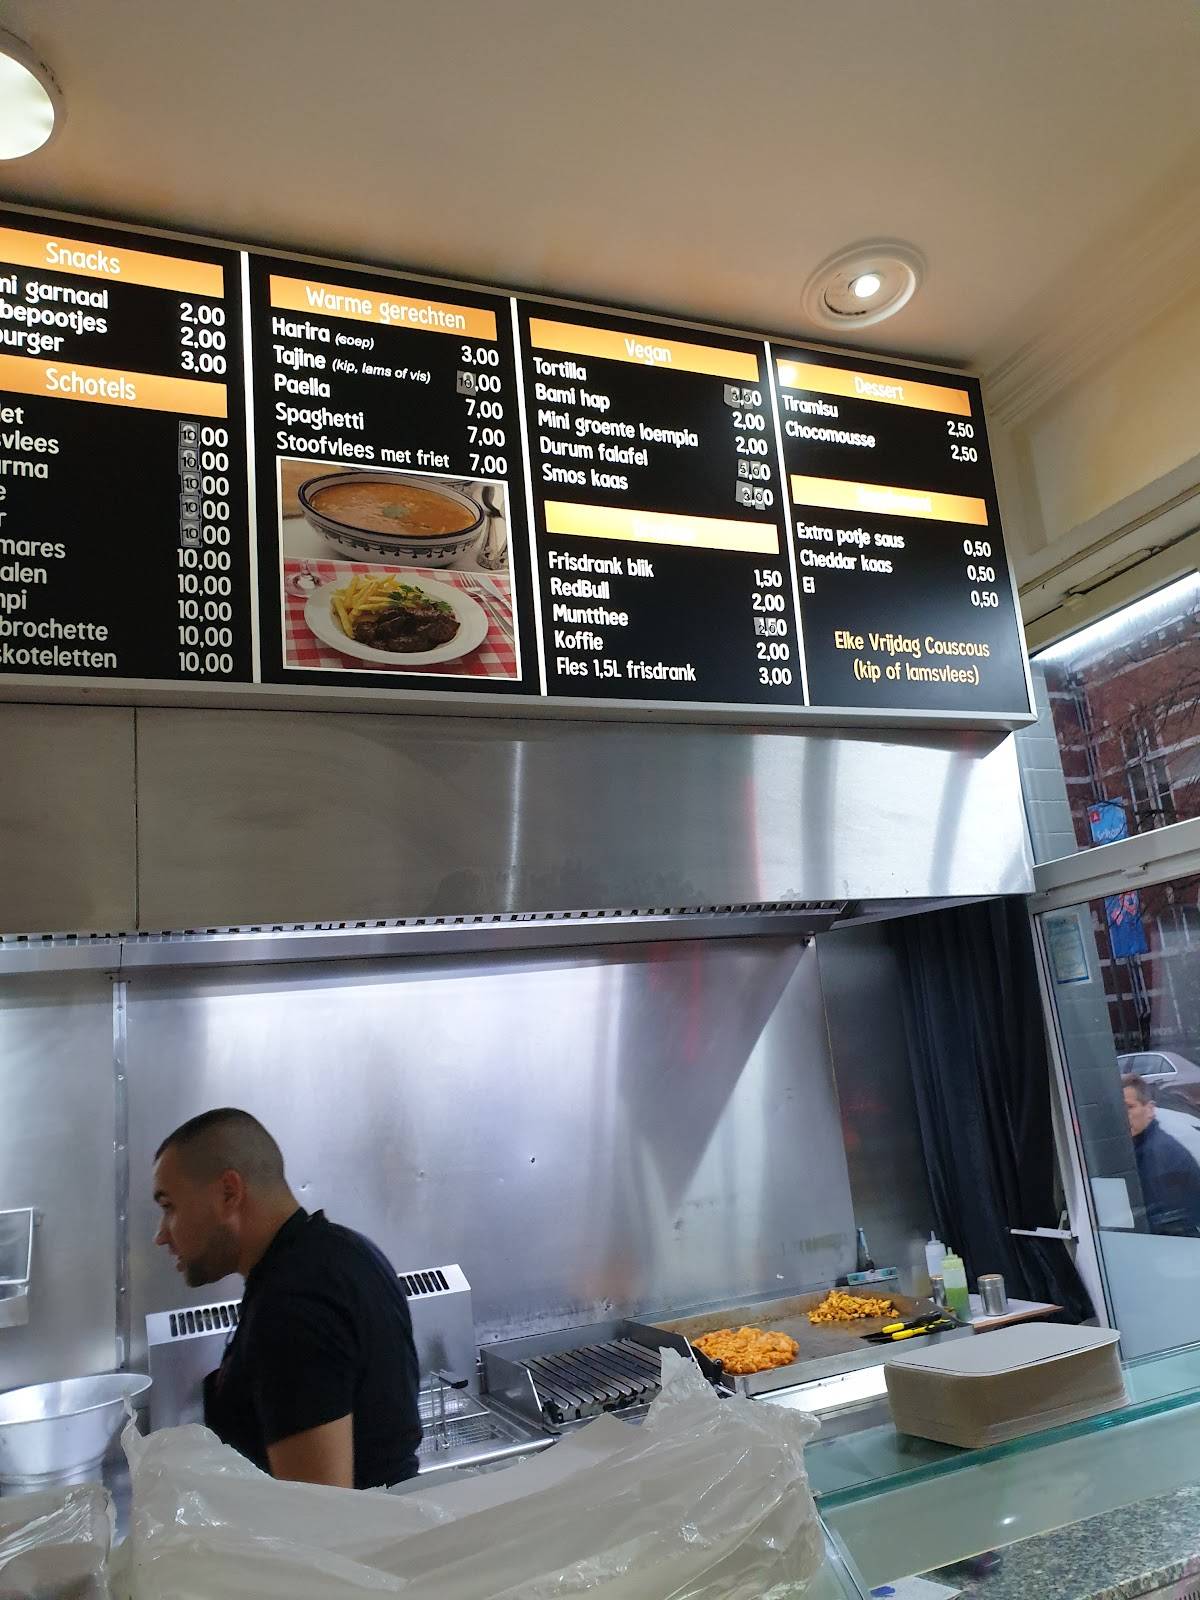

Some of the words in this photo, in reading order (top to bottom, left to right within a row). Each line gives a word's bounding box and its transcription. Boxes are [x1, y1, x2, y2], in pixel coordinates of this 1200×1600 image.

[46, 242, 120, 274] Snacks
[25, 282, 108, 309] garnaal
[180, 303, 225, 326] 2,00
[306, 286, 372, 315] Warme
[379, 303, 466, 329] gerechten
[181, 327, 226, 350] 2,00
[272, 317, 330, 342] Harira
[335, 333, 374, 350] (soep)
[181, 351, 226, 374] 3,00
[273, 345, 326, 370] Tajine
[332, 359, 357, 374] (kip,
[362, 363, 391, 376] lams
[395, 368, 408, 379] of
[410, 370, 430, 384] vis)
[462, 346, 499, 366] 3,00
[625, 339, 672, 367] Vegan
[533, 357, 586, 380] Tortilla
[46, 368, 135, 400] Schotels
[275, 373, 330, 397] Paella
[854, 376, 903, 400] Dessert
[466, 399, 503, 419] 7,00
[535, 383, 575, 404] Bami
[580, 389, 610, 412] hap
[781, 394, 840, 418] Tiramisu
[0, 404, 24, 424] et
[276, 402, 364, 430] Spaghetti
[733, 411, 765, 431] 2,00
[468, 426, 505, 447] 7,00
[538, 409, 570, 429] Mini
[575, 417, 635, 438] groente
[639, 423, 698, 448] loempia
[785, 420, 875, 447] Chocomousse
[947, 421, 974, 438] 2,50
[0, 430, 60, 454] vlees
[277, 431, 374, 459] Stoofvlees
[381, 449, 411, 463] met
[417, 450, 449, 468] friet
[540, 436, 593, 459] Durum
[598, 443, 648, 466] falafel
[735, 436, 768, 455] 2,00
[951, 445, 977, 462] 2,50
[0, 460, 48, 478] rma
[470, 454, 507, 474] 7,00
[542, 463, 586, 485] Smos
[591, 469, 628, 490] kaas
[797, 522, 833, 541] Extra
[837, 528, 870, 548] potje
[874, 534, 905, 548] saus
[177, 549, 230, 570] 10,00
[964, 540, 991, 557] 0,50
[549, 551, 623, 575] Frisdrank
[627, 558, 654, 577] blik
[800, 549, 857, 569] Cheddar
[861, 555, 893, 573] kaas
[0, 562, 46, 584] alen
[754, 570, 782, 588] 1,50
[967, 565, 995, 582] 0,50
[178, 574, 231, 596] 10,00
[551, 577, 609, 599] RedBull
[803, 577, 815, 593] Ei
[178, 600, 232, 622] 10,00
[752, 593, 784, 612] 2,00
[971, 591, 998, 608] 0,50
[553, 604, 628, 626] Muntthee
[0, 615, 108, 641] brochette
[179, 626, 232, 648] 10,00
[555, 630, 603, 650] Koffie
[757, 642, 789, 661] 2,00
[835, 631, 864, 650] Elke
[869, 633, 921, 658] Vrijdag
[925, 637, 990, 657] Couscous
[0, 643, 116, 668] koteletten
[179, 652, 233, 674] 10,00
[557, 657, 588, 676] Fles
[593, 659, 621, 678] 1,5L
[627, 660, 696, 681] frisdrank
[759, 667, 792, 686] 3,00
[854, 658, 881, 683] (kip
[886, 662, 901, 679] of
[906, 663, 979, 685] lamsvlees)
